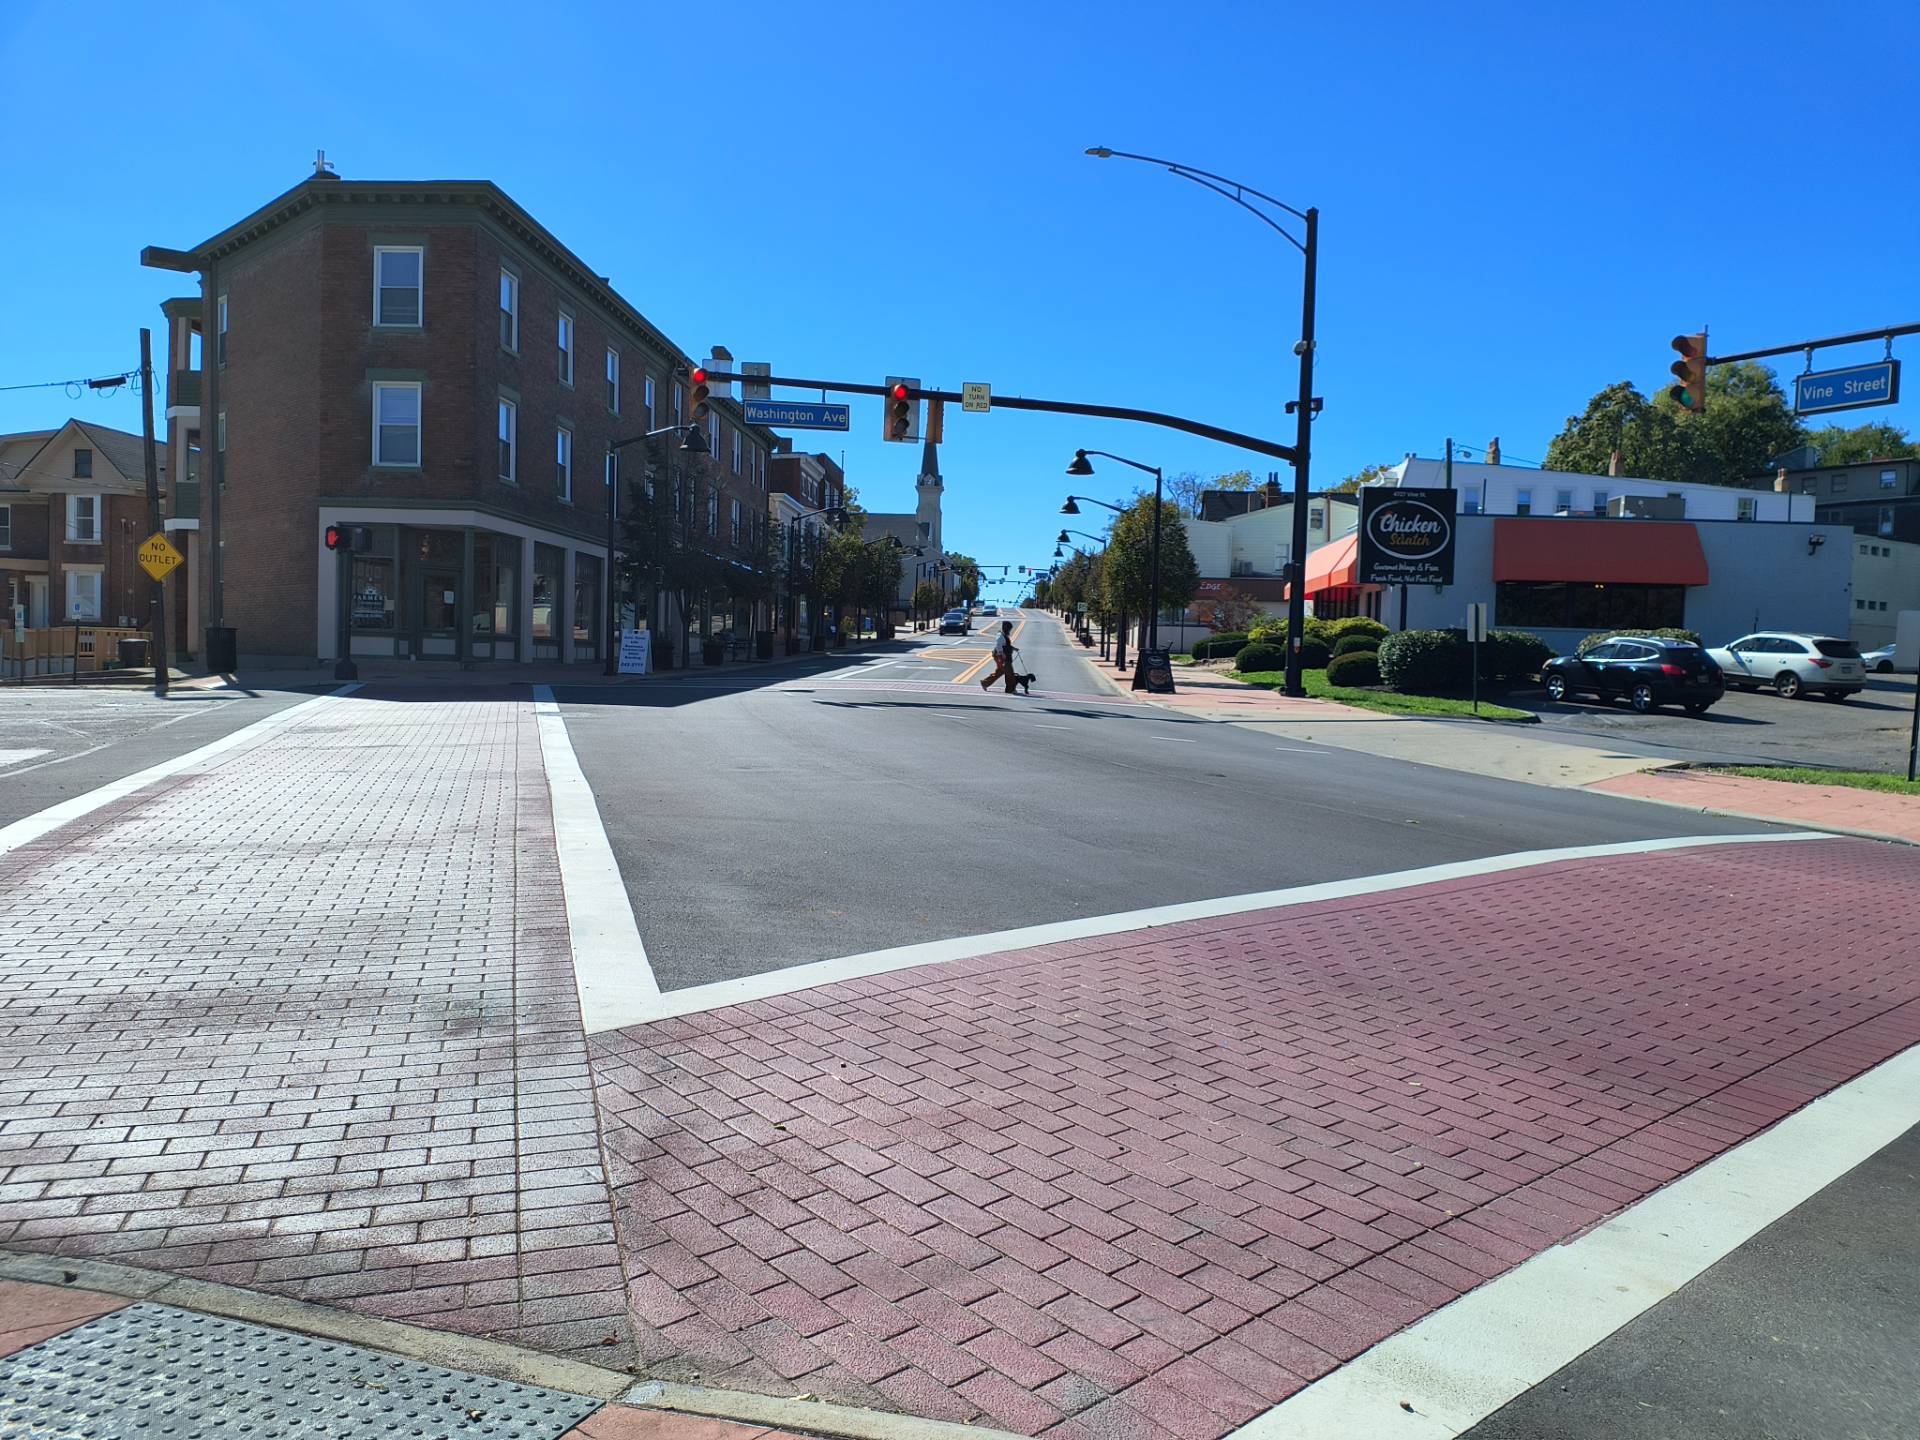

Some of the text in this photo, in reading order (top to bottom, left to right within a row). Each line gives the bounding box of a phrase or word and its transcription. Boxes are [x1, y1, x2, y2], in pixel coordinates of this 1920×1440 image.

[1803, 376, 1887, 400] Vine Street
[746, 406, 846, 423] Washington Ave
[1379, 512, 1441, 534] Chicken
[151, 542, 166, 551] NO
[1389, 534, 1432, 546] Scratch
[139, 553, 177, 565] OUTLET
